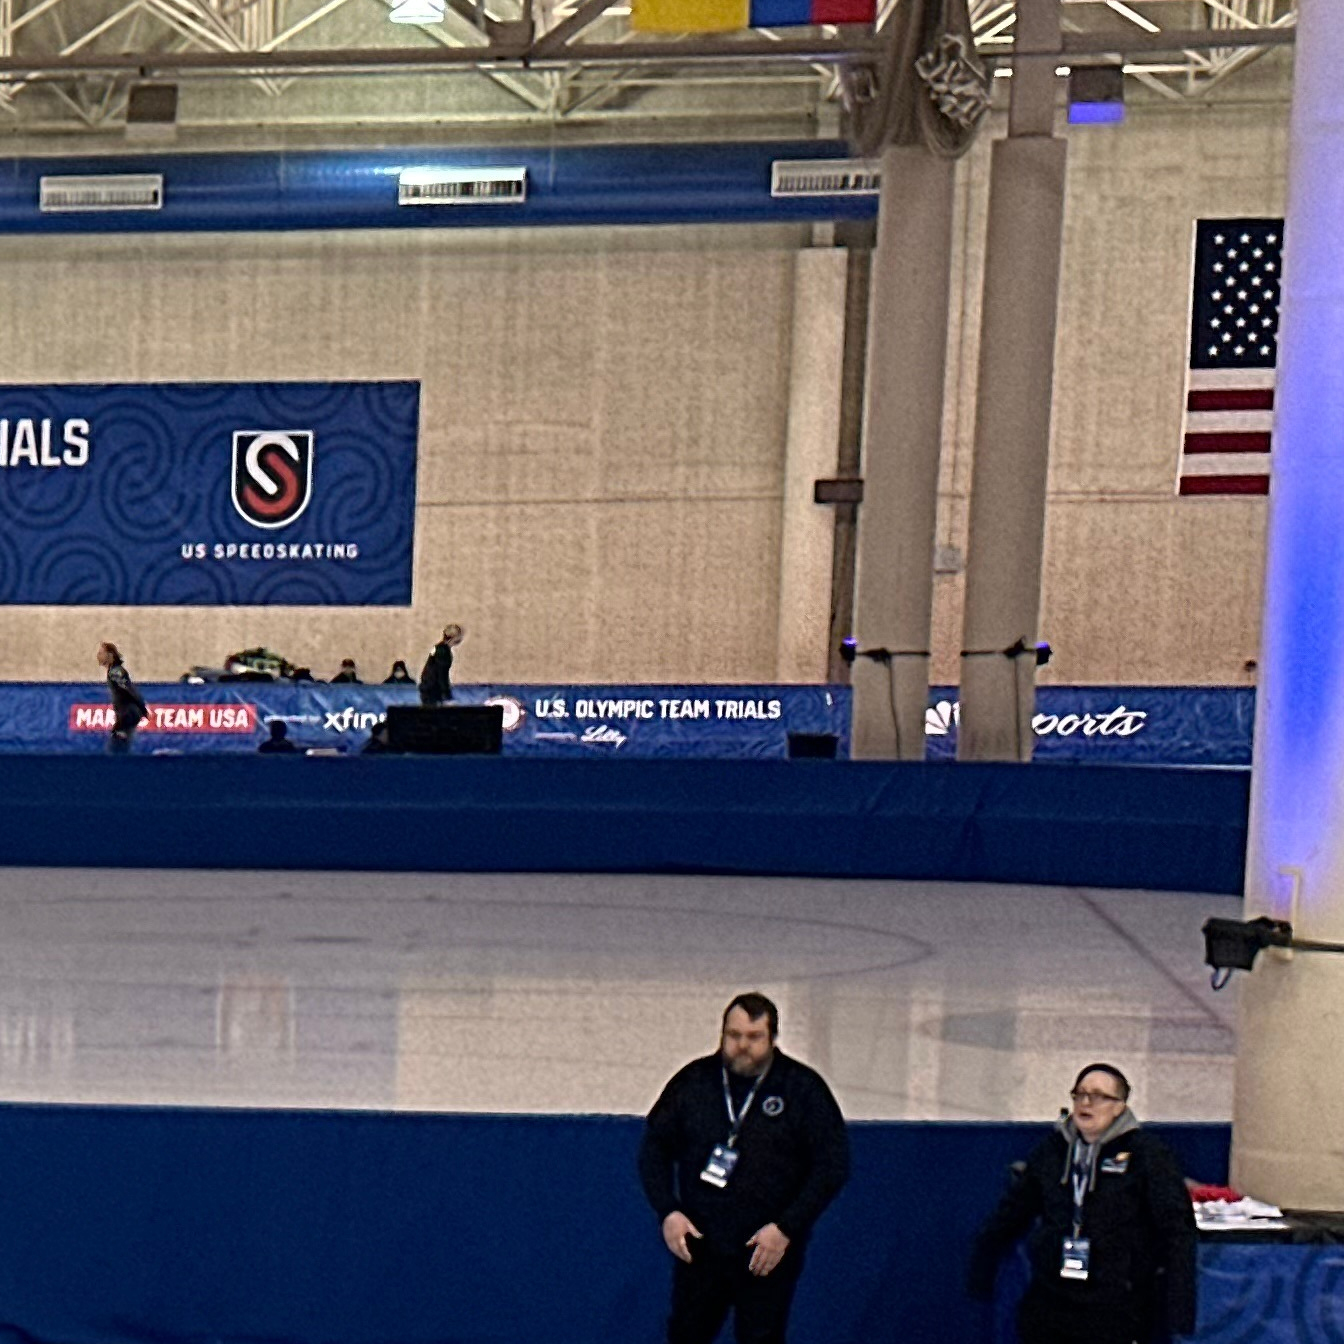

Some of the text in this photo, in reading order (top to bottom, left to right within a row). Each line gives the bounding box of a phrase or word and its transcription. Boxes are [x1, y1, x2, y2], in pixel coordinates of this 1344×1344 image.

[181, 543, 358, 559] US SPEEDSKATING
[154, 708, 203, 727] TEAM
[209, 709, 249, 728] USA
[535, 698, 570, 718] U.S.
[575, 699, 655, 719] OLYMPIC
[658, 699, 710, 719] TEAM
[714, 699, 781, 720] TRIALS
